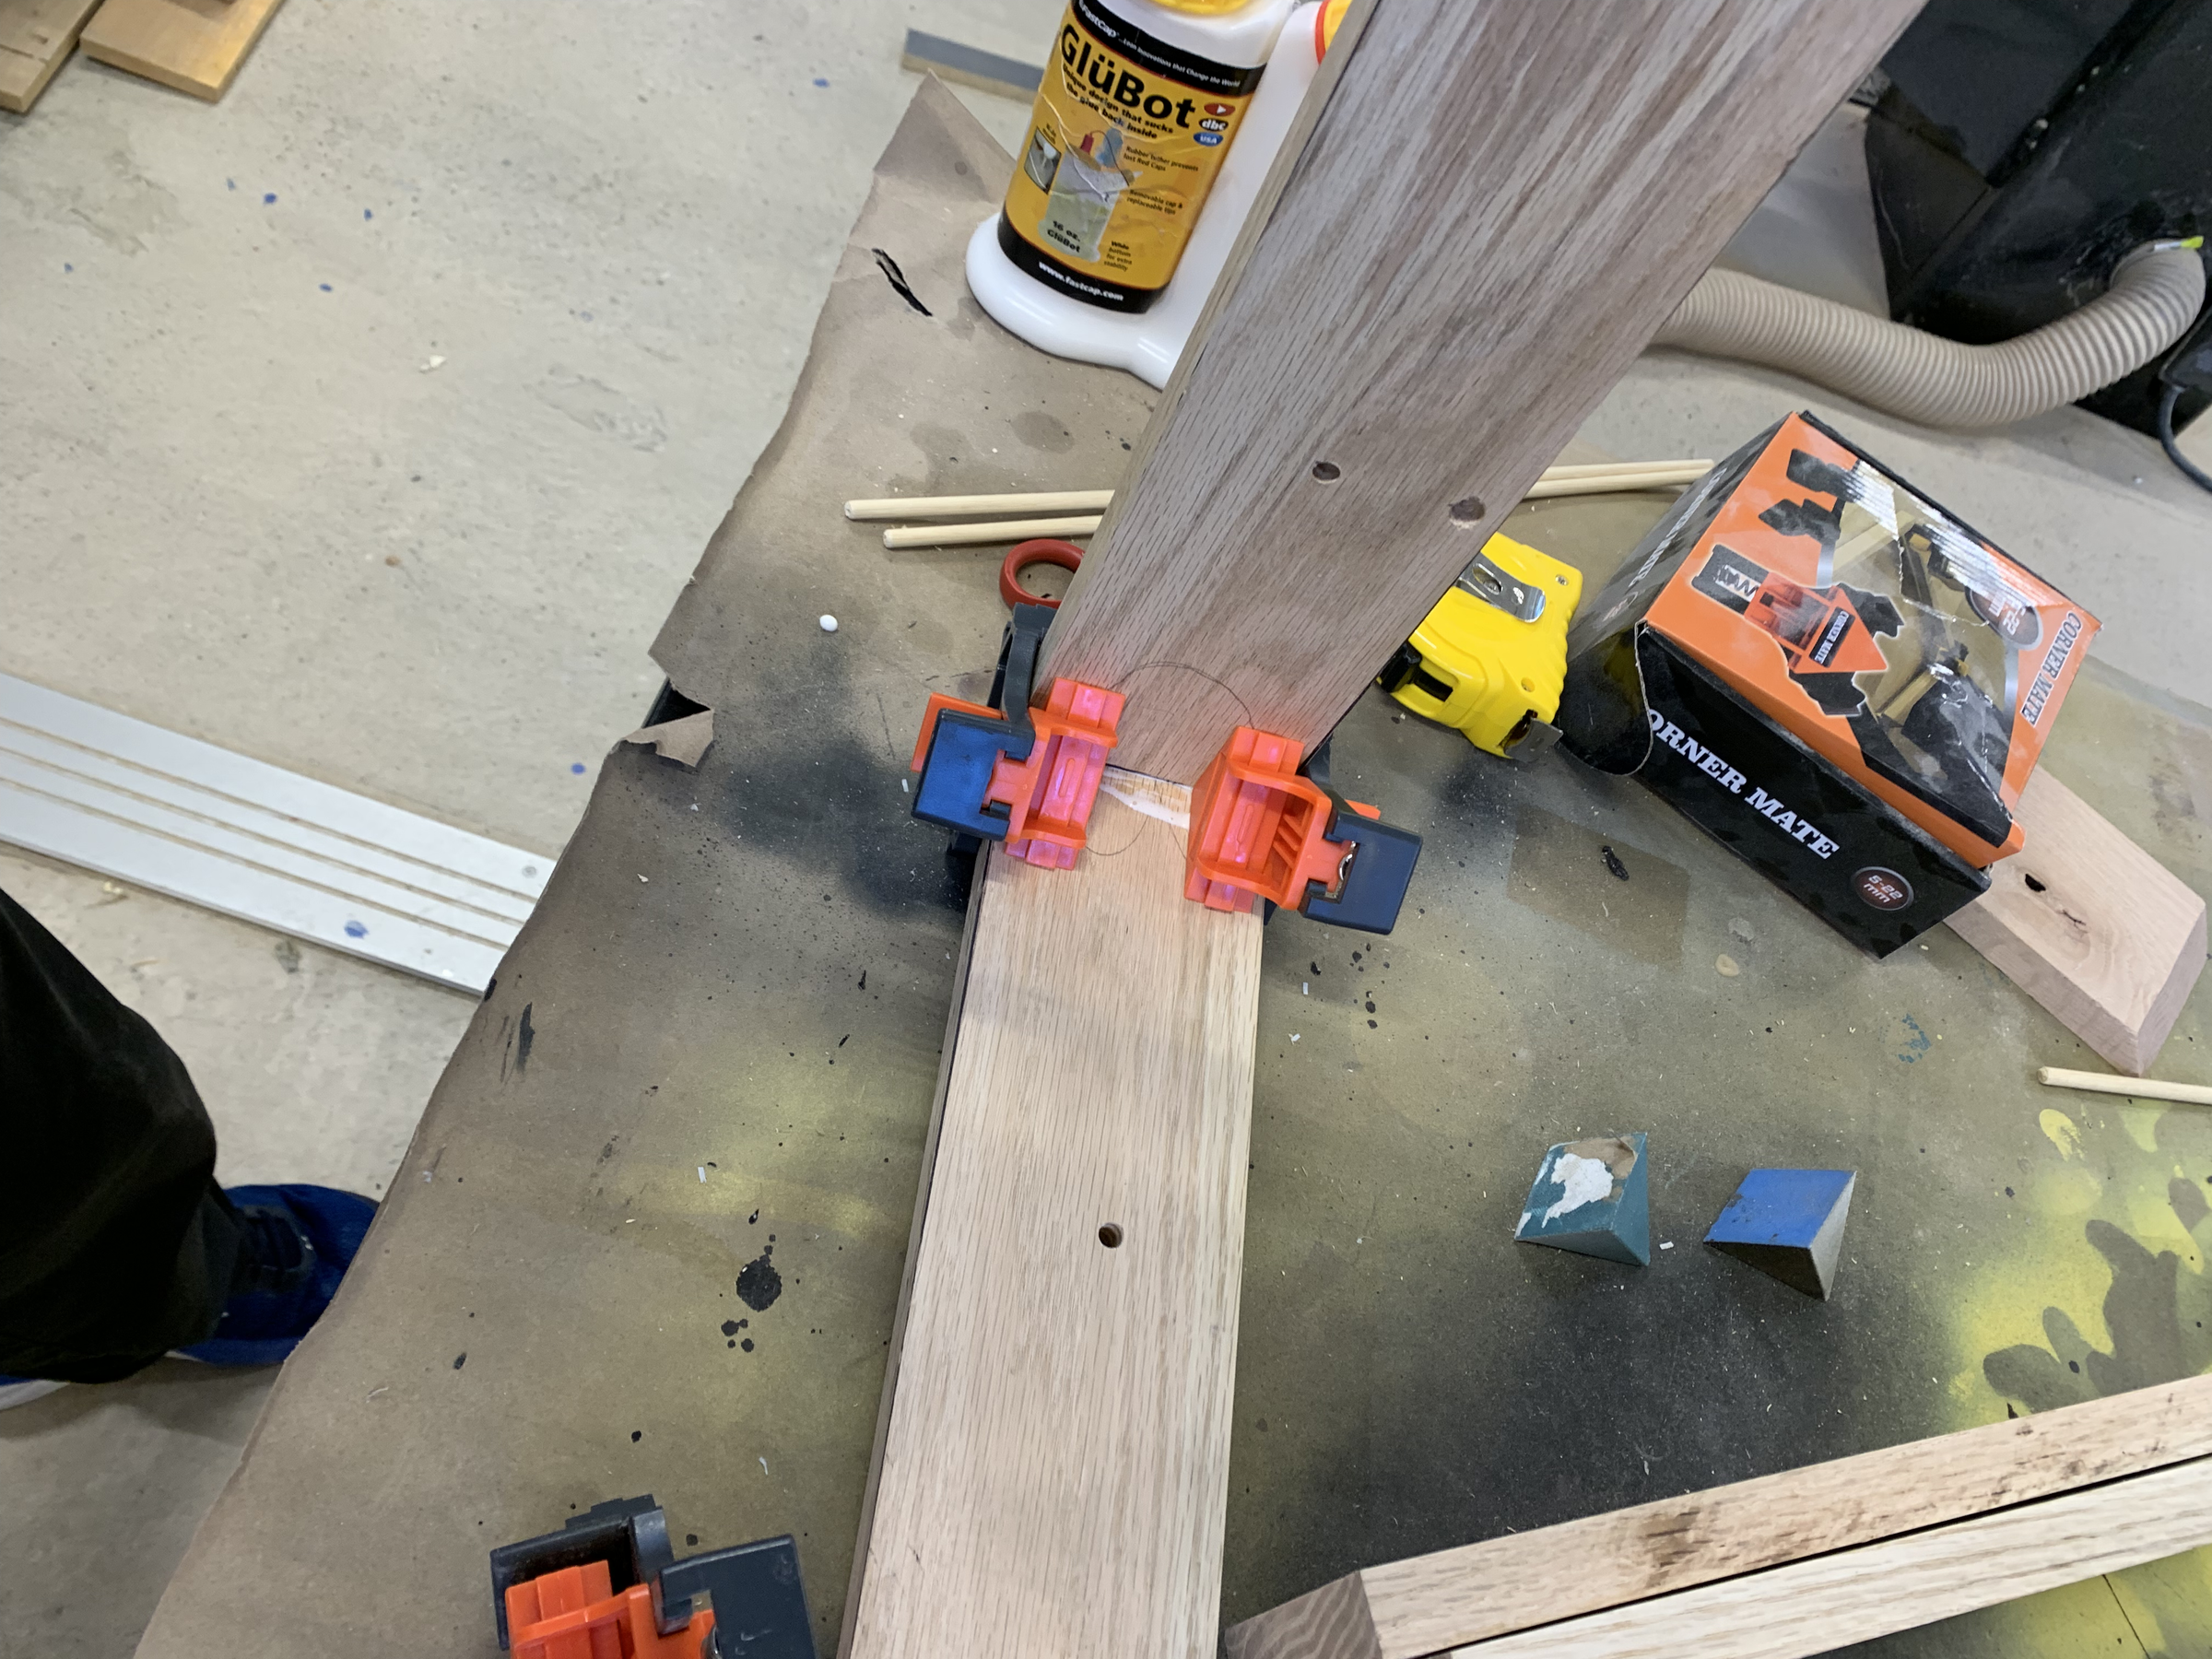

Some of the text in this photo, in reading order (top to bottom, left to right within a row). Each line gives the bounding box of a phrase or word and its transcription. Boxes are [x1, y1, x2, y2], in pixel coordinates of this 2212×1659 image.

[1062, 23, 1196, 129] GlüBot
[1137, 46, 1171, 68] Innovations
[1172, 62, 1186, 73] that
[1186, 67, 1208, 81] Change
[1210, 76, 1221, 84] the
[1221, 78, 1241, 88] World
[1063, 63, 1173, 134] Unique design that sucks
[1066, 82, 1158, 139] the glue back inside
[1201, 118, 1227, 131] dbc
[1200, 135, 1218, 144] USA
[1124, 153, 1136, 162] lost
[1150, 162, 1166, 171] Caps
[1126, 146, 1149, 159] Rubber
[1171, 160, 1199, 172] prevents
[1127, 196, 1176, 215] replaceable tips
[1129, 189, 1164, 205] Removable
[1165, 199, 1177, 208] cap
[1047, 229, 1081, 253] GlüBot
[1053, 220, 1080, 242] 16 oz.
[1038, 261, 1124, 302] www.fastcap.com
[2019, 609, 2083, 728] CORNER MATE
[1647, 708, 1841, 860] ORNER MATE
[1863, 883, 1891, 903] mm
[1868, 875, 1903, 900] 5-22
